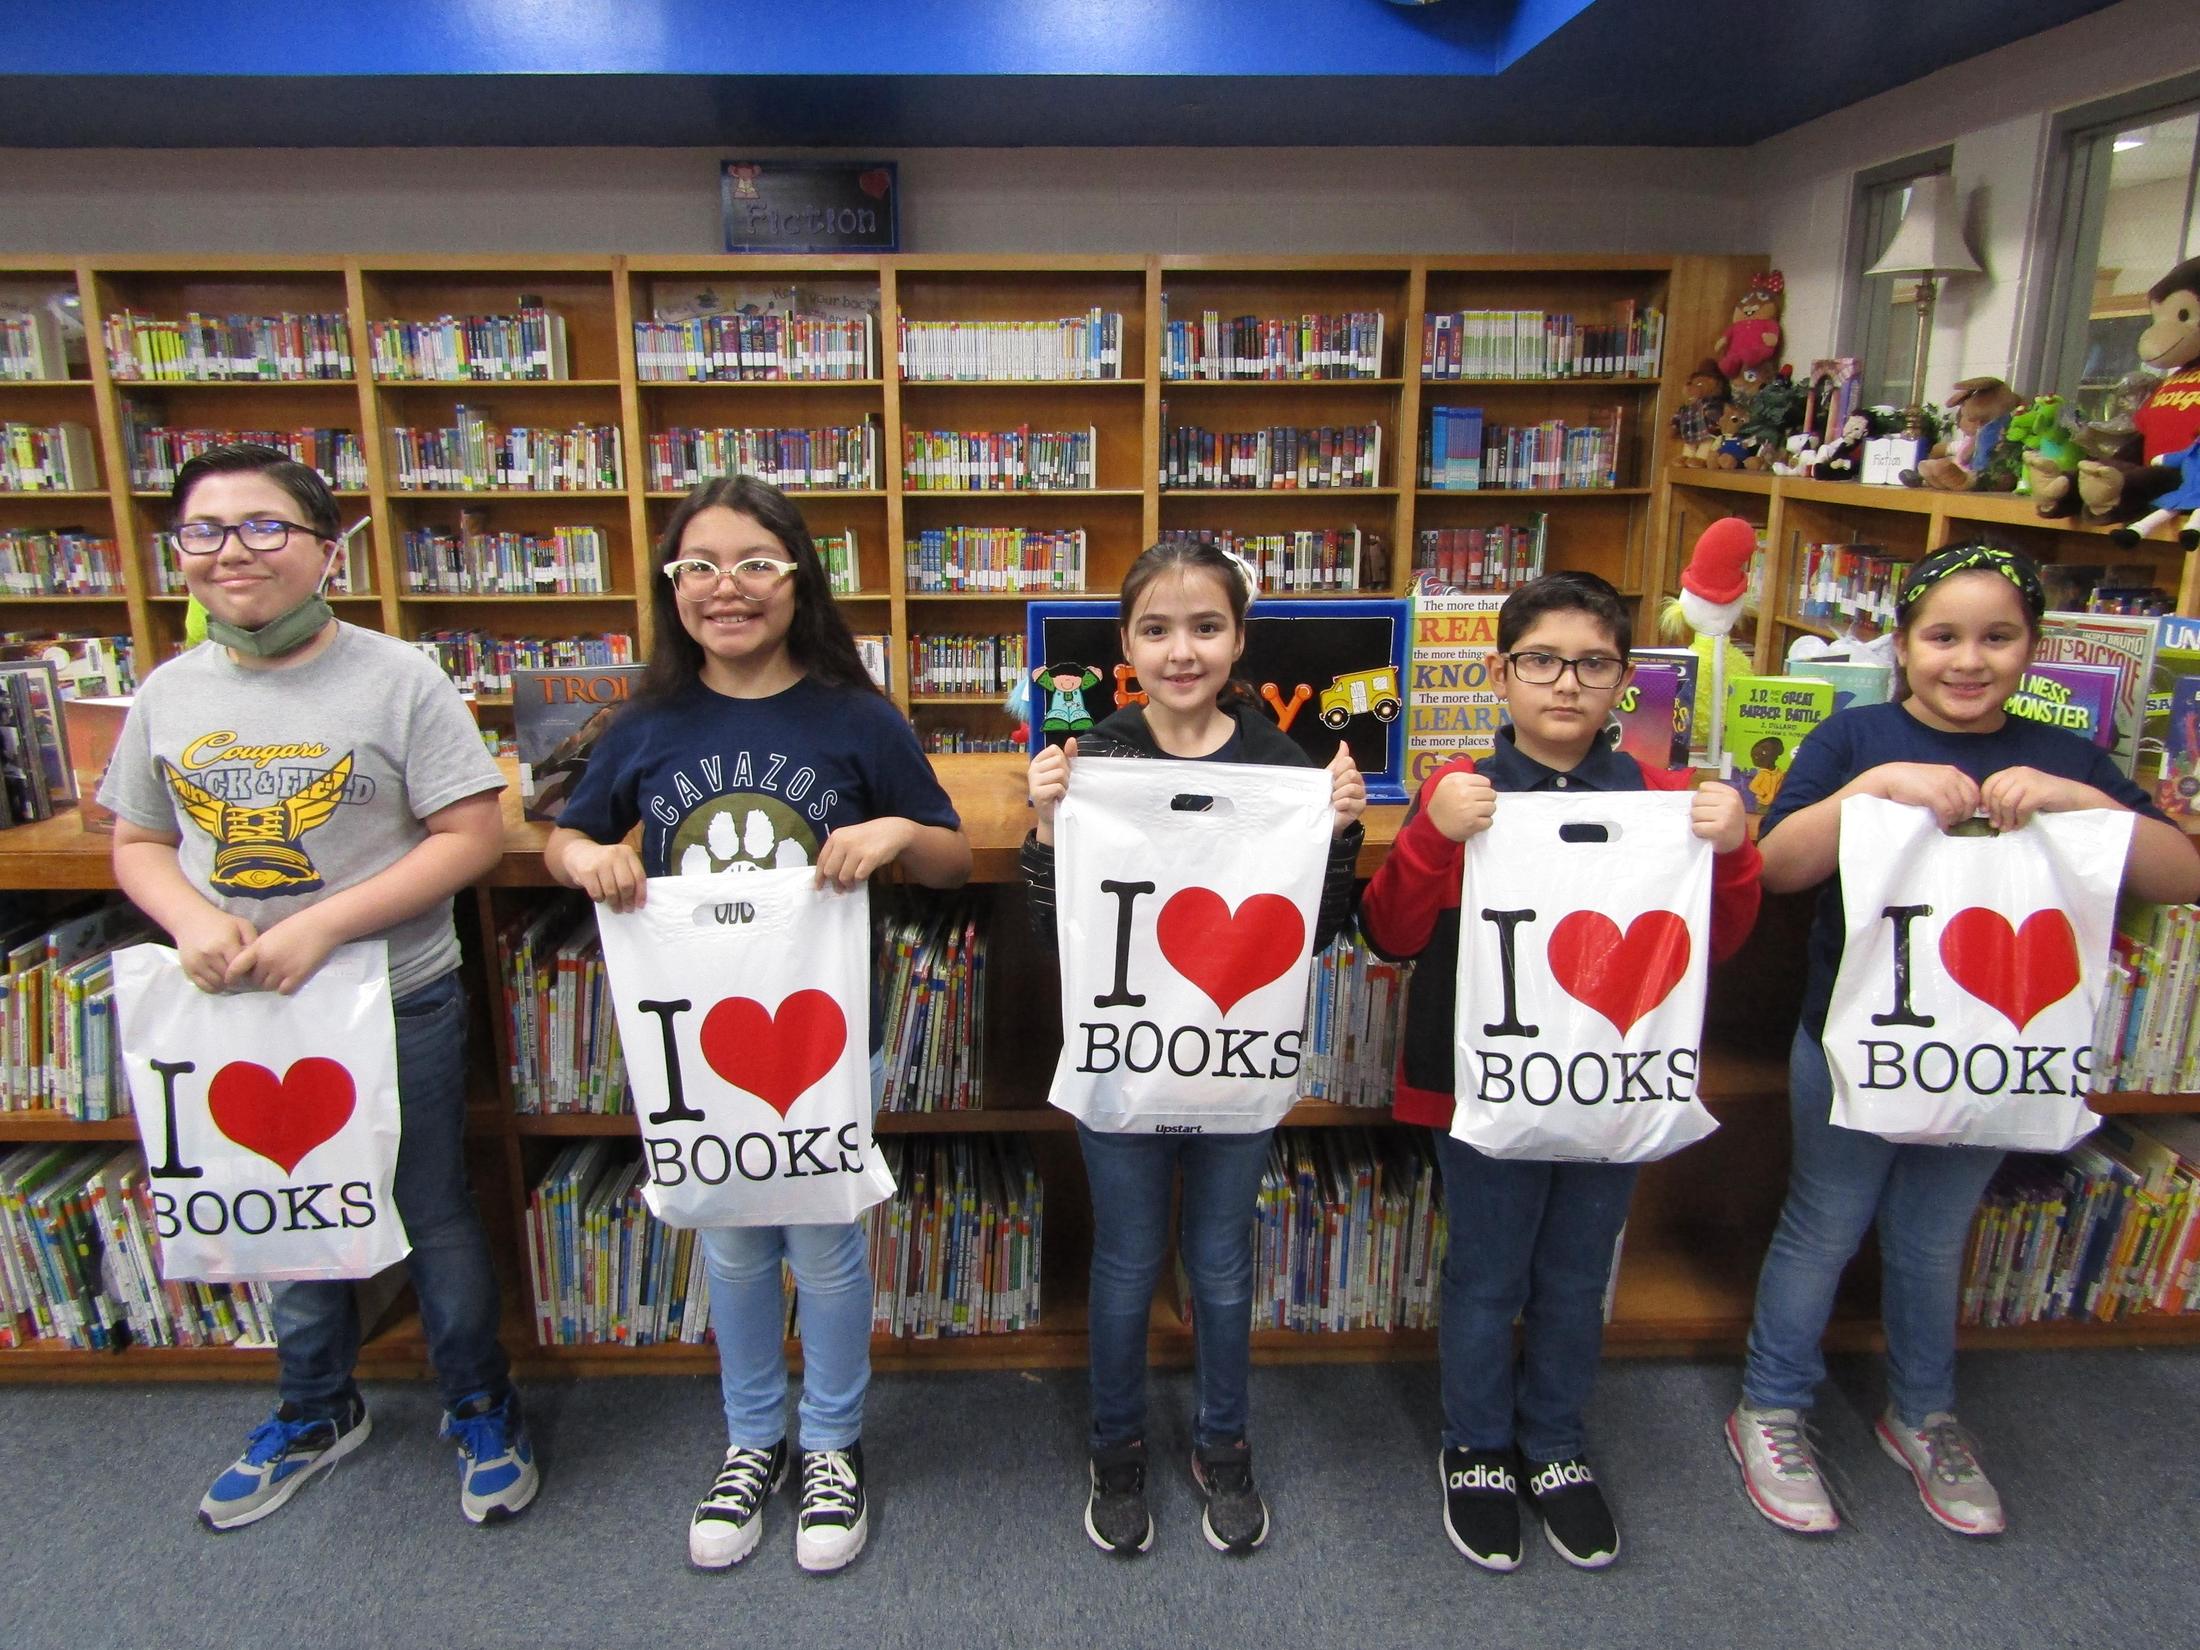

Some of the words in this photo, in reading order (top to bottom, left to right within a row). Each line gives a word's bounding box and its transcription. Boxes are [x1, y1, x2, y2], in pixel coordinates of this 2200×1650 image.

[746, 203, 876, 235] Fiction
[1424, 600, 1444, 610] The
[1447, 602, 1474, 610] more
[1478, 600, 1498, 610] that
[1419, 616, 1495, 642] REA
[2107, 633, 2144, 656] BRUNO
[1414, 650, 1429, 659] the
[1431, 651, 1456, 659] more
[1458, 649, 1486, 660] things
[1413, 663, 1487, 689] KNO
[2028, 674, 2072, 705] NESS
[1419, 693, 1439, 703] The
[1442, 695, 1470, 703] more
[1473, 693, 1494, 703] that
[1739, 704, 1781, 720] BARBER
[1785, 708, 1821, 723] BATTLE
[1781, 691, 1815, 706] GREAT
[2003, 693, 2089, 730] MONSTER
[182, 730, 328, 769] Cougars
[1411, 736, 1427, 746] the
[1430, 738, 1455, 746] more
[1458, 736, 1489, 748] places
[255, 770, 275, 795] &
[278, 767, 376, 806] FIELD
[651, 751, 838, 826] CAVAZOS
[1094, 879, 1156, 1009] I
[1481, 908, 1540, 1038] I
[1871, 904, 1935, 1028] I
[638, 998, 706, 1126] I
[1076, 1020, 1305, 1081] BOOKS
[1475, 1048, 1698, 1107] BOOKS
[1858, 1039, 2093, 1099] BOOKS
[150, 1057, 204, 1179] I
[1155, 1124, 1203, 1134] Upstart
[645, 1120, 877, 1187] BOOKS
[152, 1180, 377, 1239] BOOKS
[1450, 1464, 1516, 1495] adida
[1530, 1460, 1594, 1496] adida
